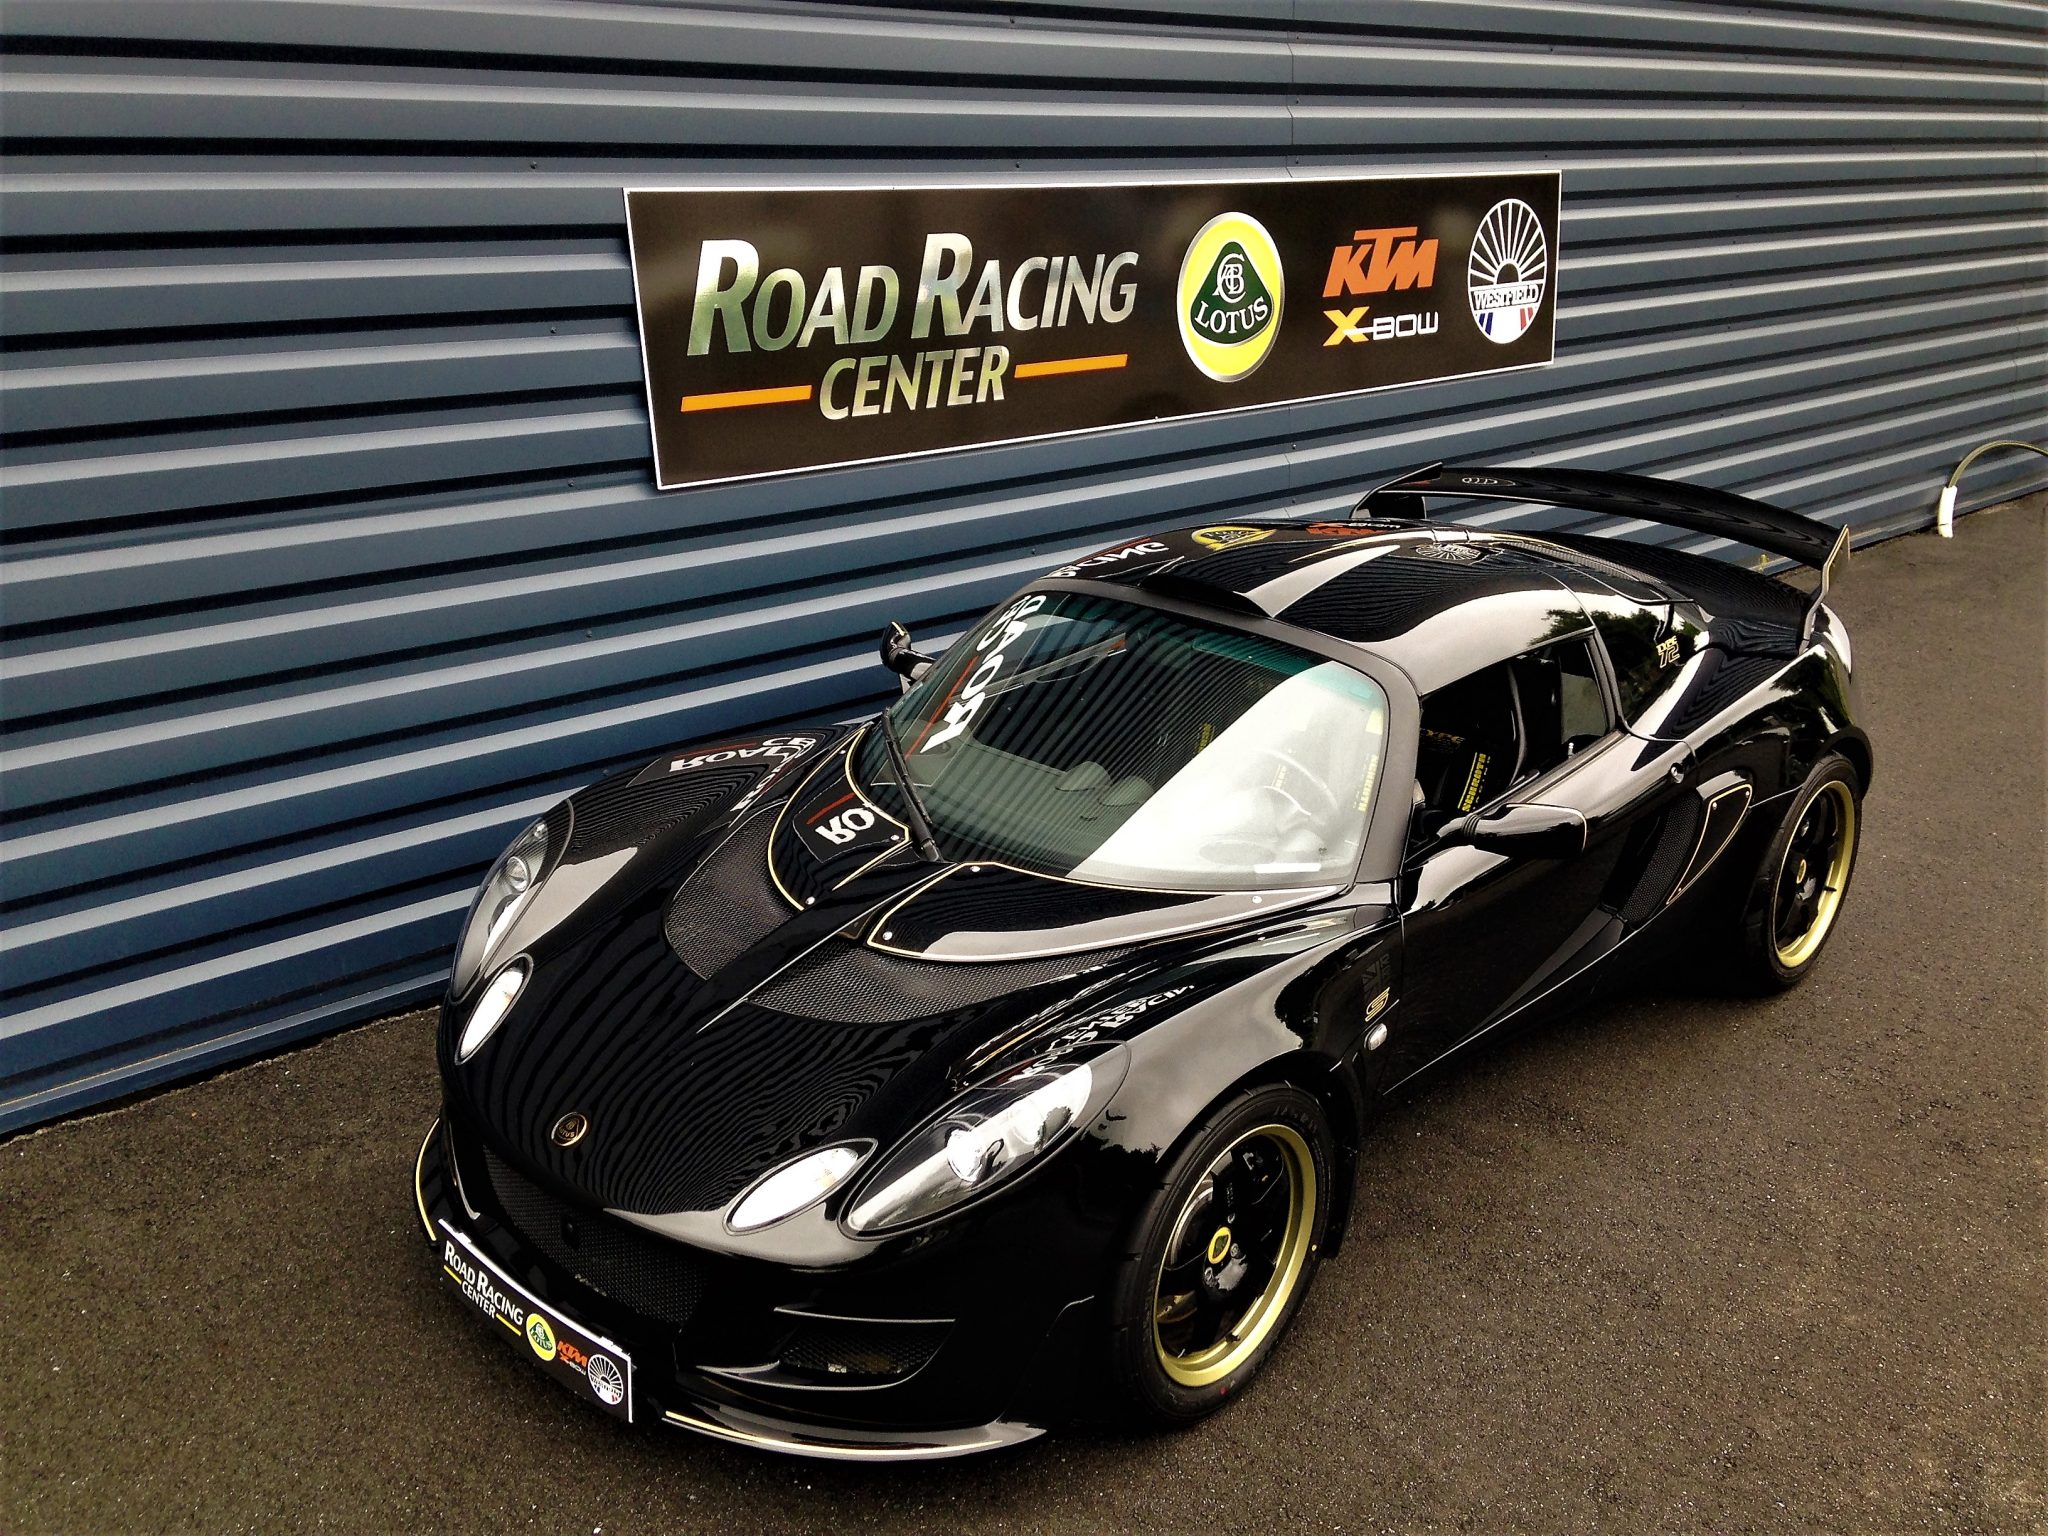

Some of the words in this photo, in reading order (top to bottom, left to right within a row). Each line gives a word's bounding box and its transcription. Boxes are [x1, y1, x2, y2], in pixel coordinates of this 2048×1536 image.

[1322, 226, 1439, 298] KTM
[687, 239, 899, 356] ROAD
[911, 233, 1139, 339] RACING
[1194, 296, 1268, 334] LOTUS
[1473, 284, 1539, 311] WESTFIELD
[819, 345, 1010, 420] CENTER
[445, 1240, 475, 1285] ROAD
[477, 1270, 523, 1325] RACING
[462, 1281, 496, 1319] CENTER
[557, 1340, 587, 1368] KTM
